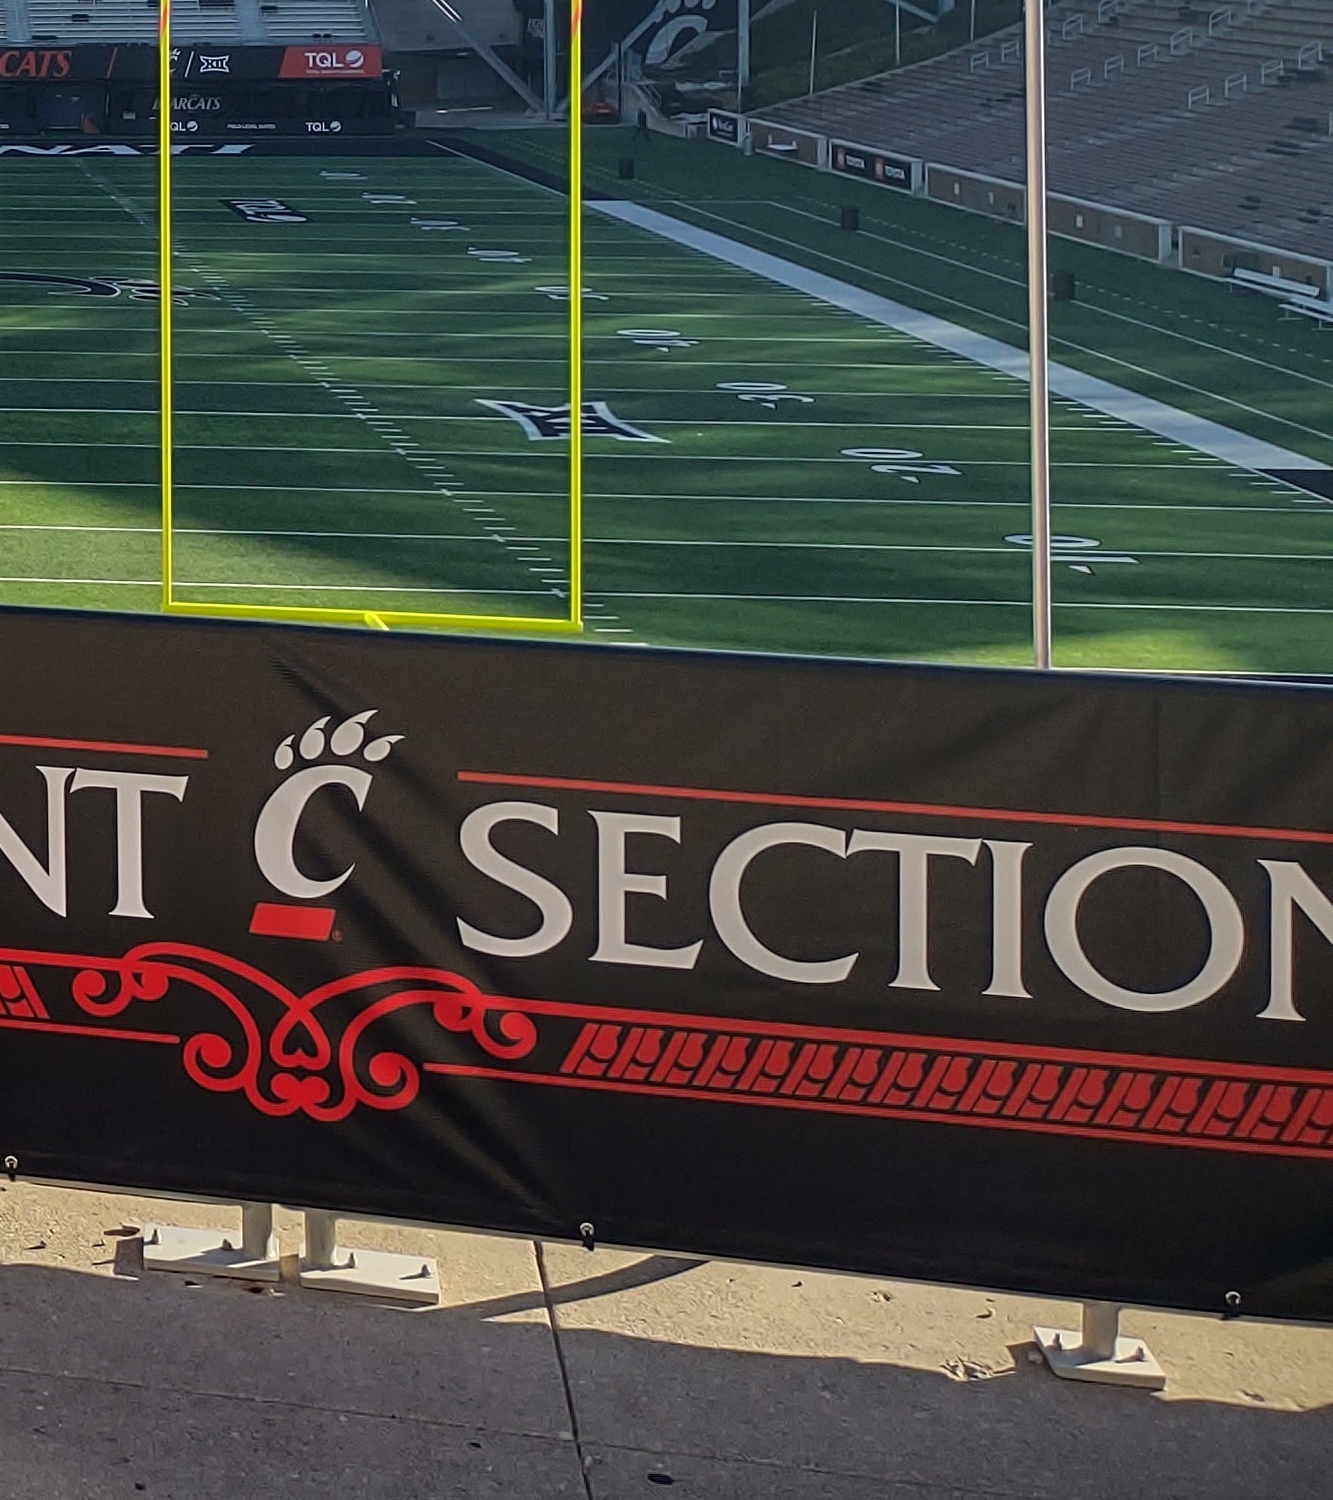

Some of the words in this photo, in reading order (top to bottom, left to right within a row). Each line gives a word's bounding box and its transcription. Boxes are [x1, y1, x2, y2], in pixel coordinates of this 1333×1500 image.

[303, 52, 344, 68] TQL
[152, 96, 222, 110] ARCATS
[170, 121, 186, 132] QL
[305, 122, 330, 132] TQL
[839, 447, 964, 476] 20
